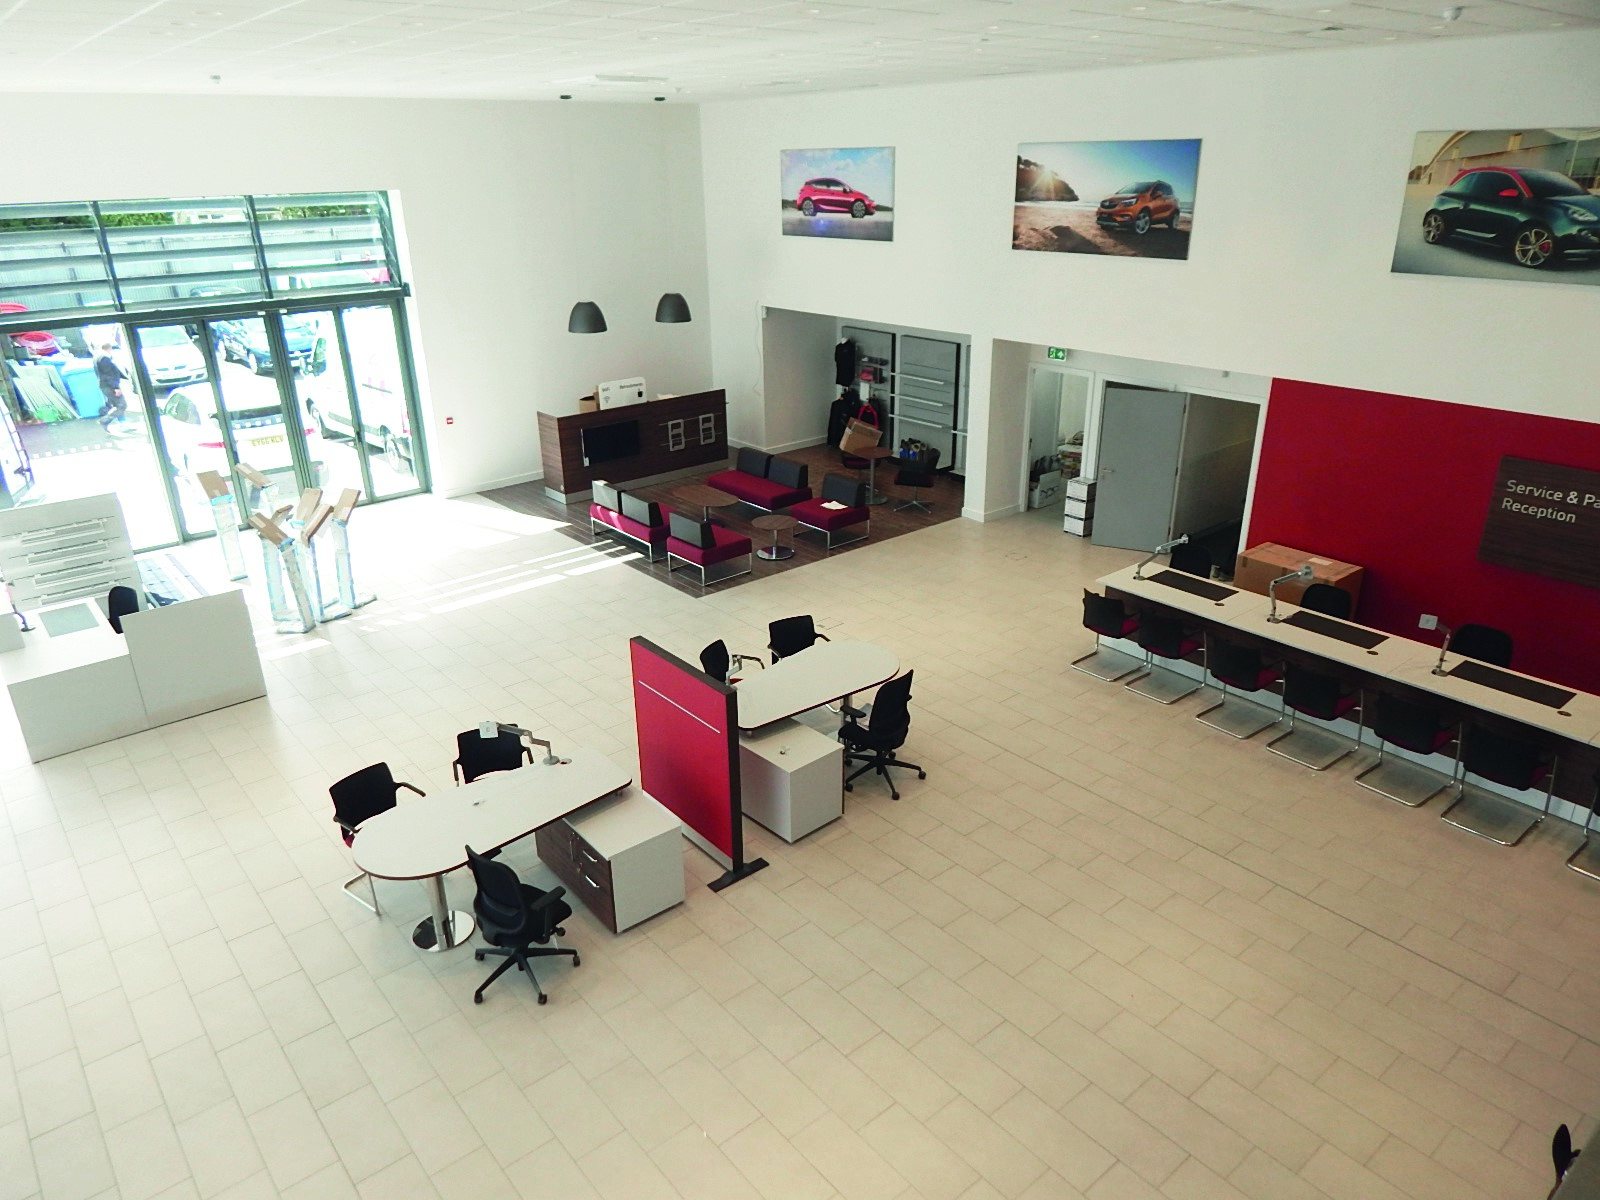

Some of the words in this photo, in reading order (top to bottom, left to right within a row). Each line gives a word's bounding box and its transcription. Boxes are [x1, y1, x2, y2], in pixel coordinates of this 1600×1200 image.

[1506, 479, 1564, 501] Service
[1566, 491, 1579, 504] &
[1501, 497, 1577, 523] Reception
